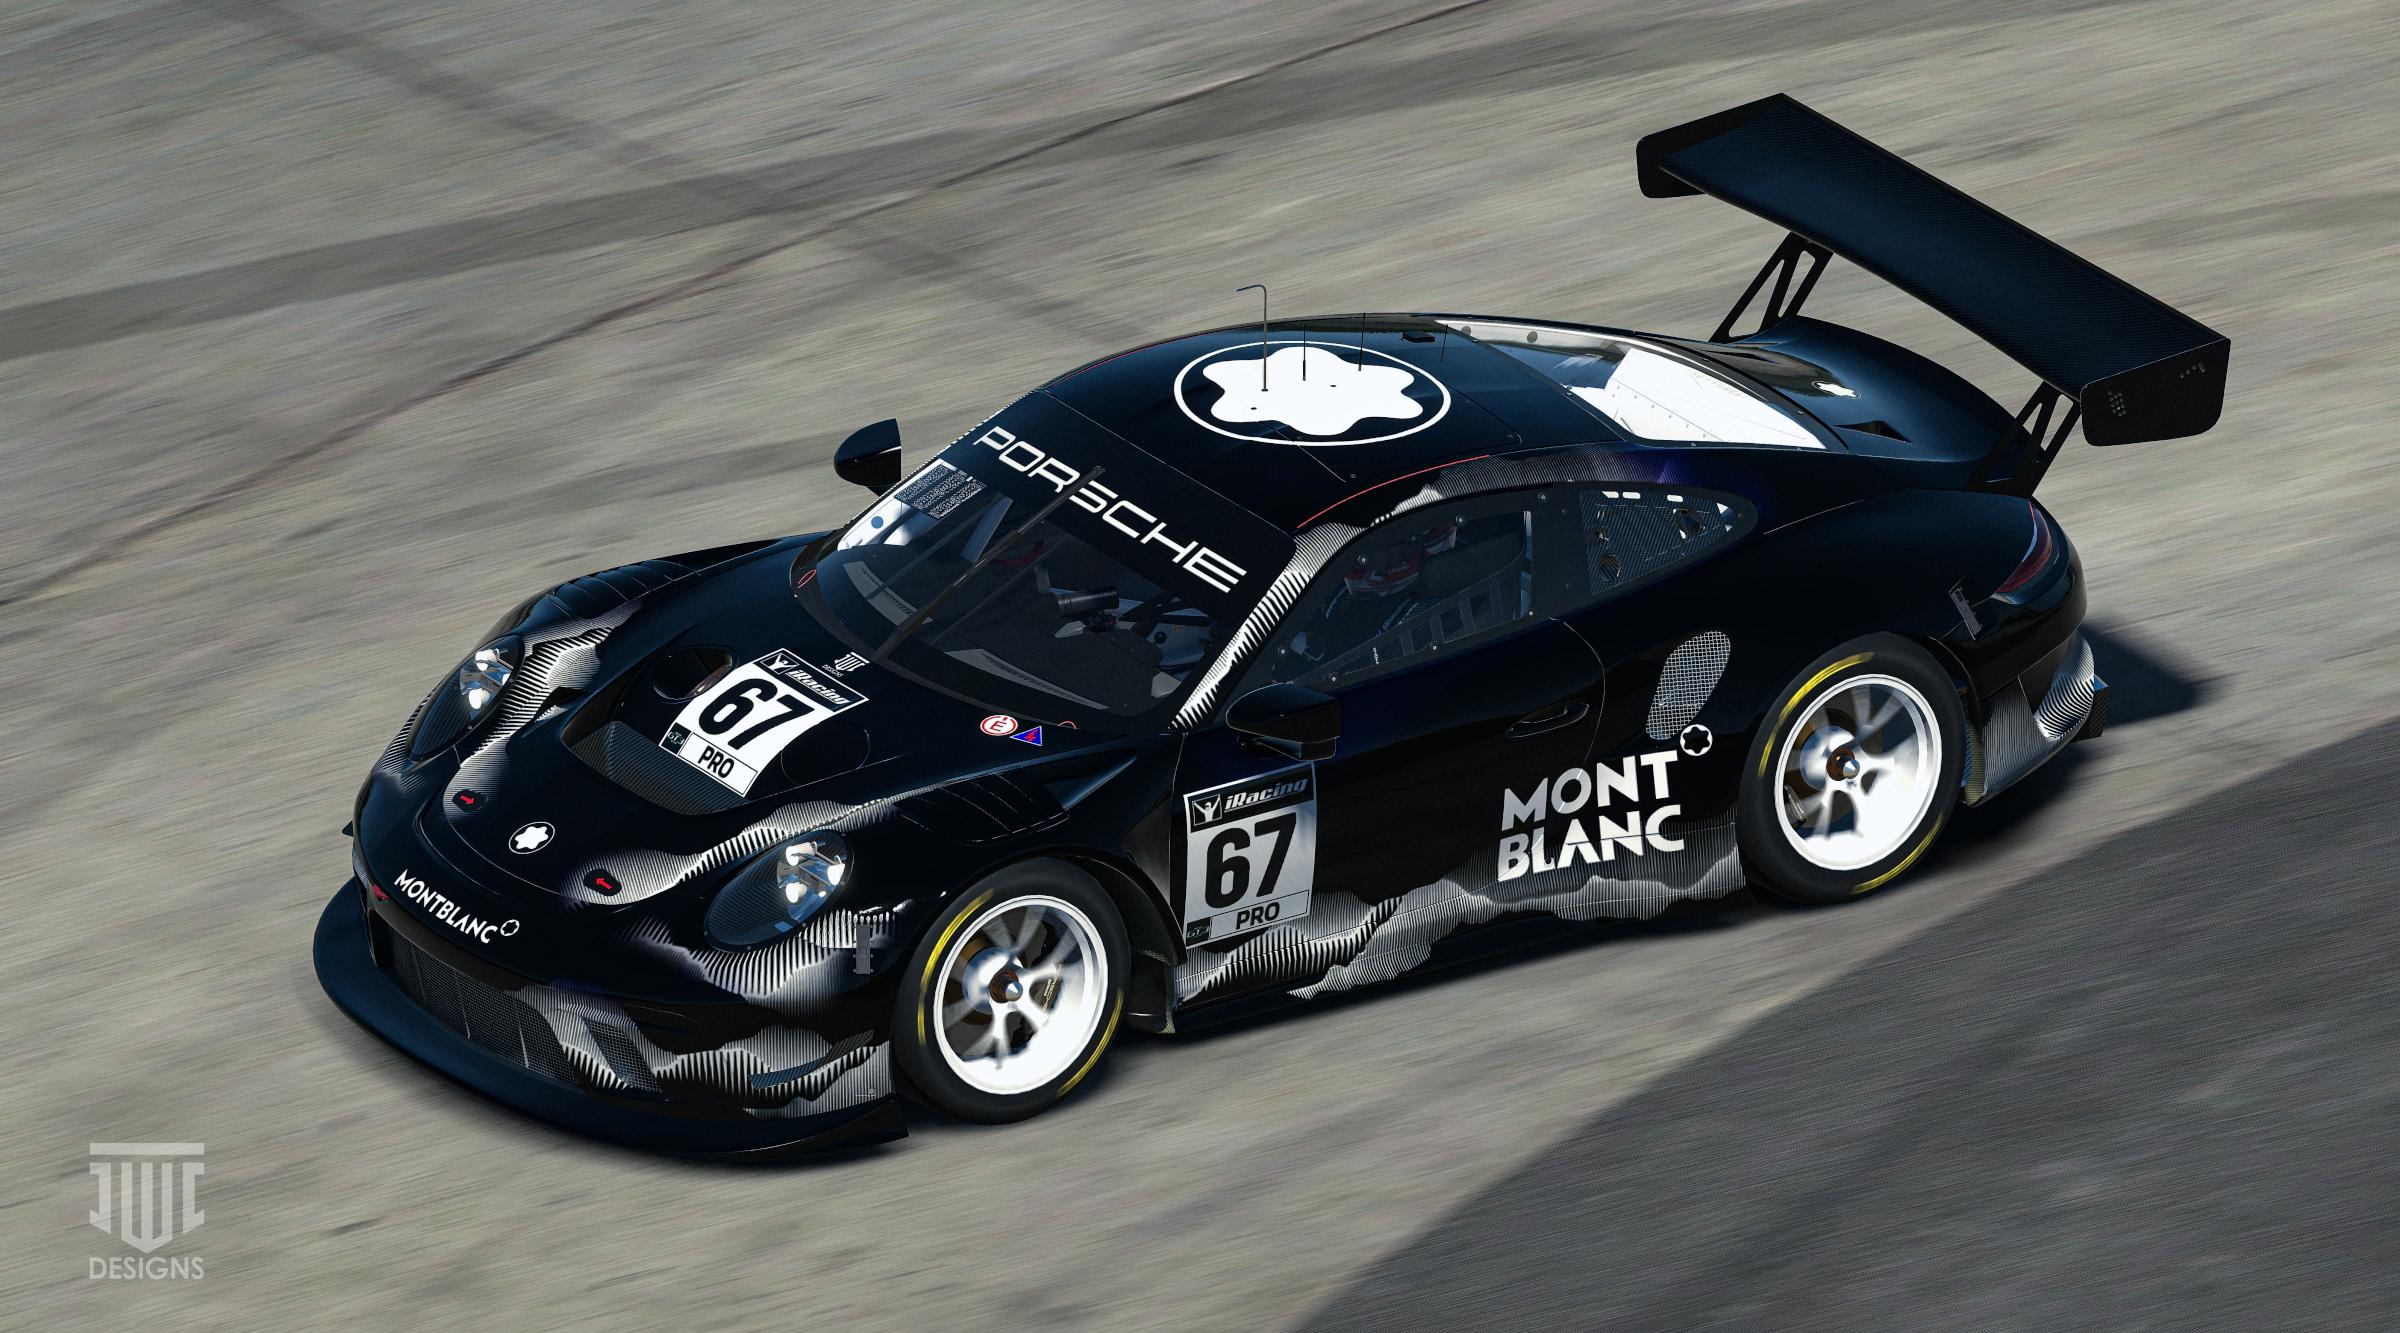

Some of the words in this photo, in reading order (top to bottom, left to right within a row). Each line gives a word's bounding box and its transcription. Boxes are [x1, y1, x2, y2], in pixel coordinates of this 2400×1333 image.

[972, 426, 1247, 593] PORSCHE
[698, 678, 815, 750] 67
[786, 669, 852, 705] iRacing
[698, 745, 735, 778] PRO
[1225, 778, 1308, 811] iRacing
[1502, 750, 1678, 831] MONT
[1205, 812, 1297, 909] 67
[1498, 804, 1685, 882] BLANC
[394, 868, 498, 944] MONTBLANC
[1236, 901, 1280, 930] PRO
